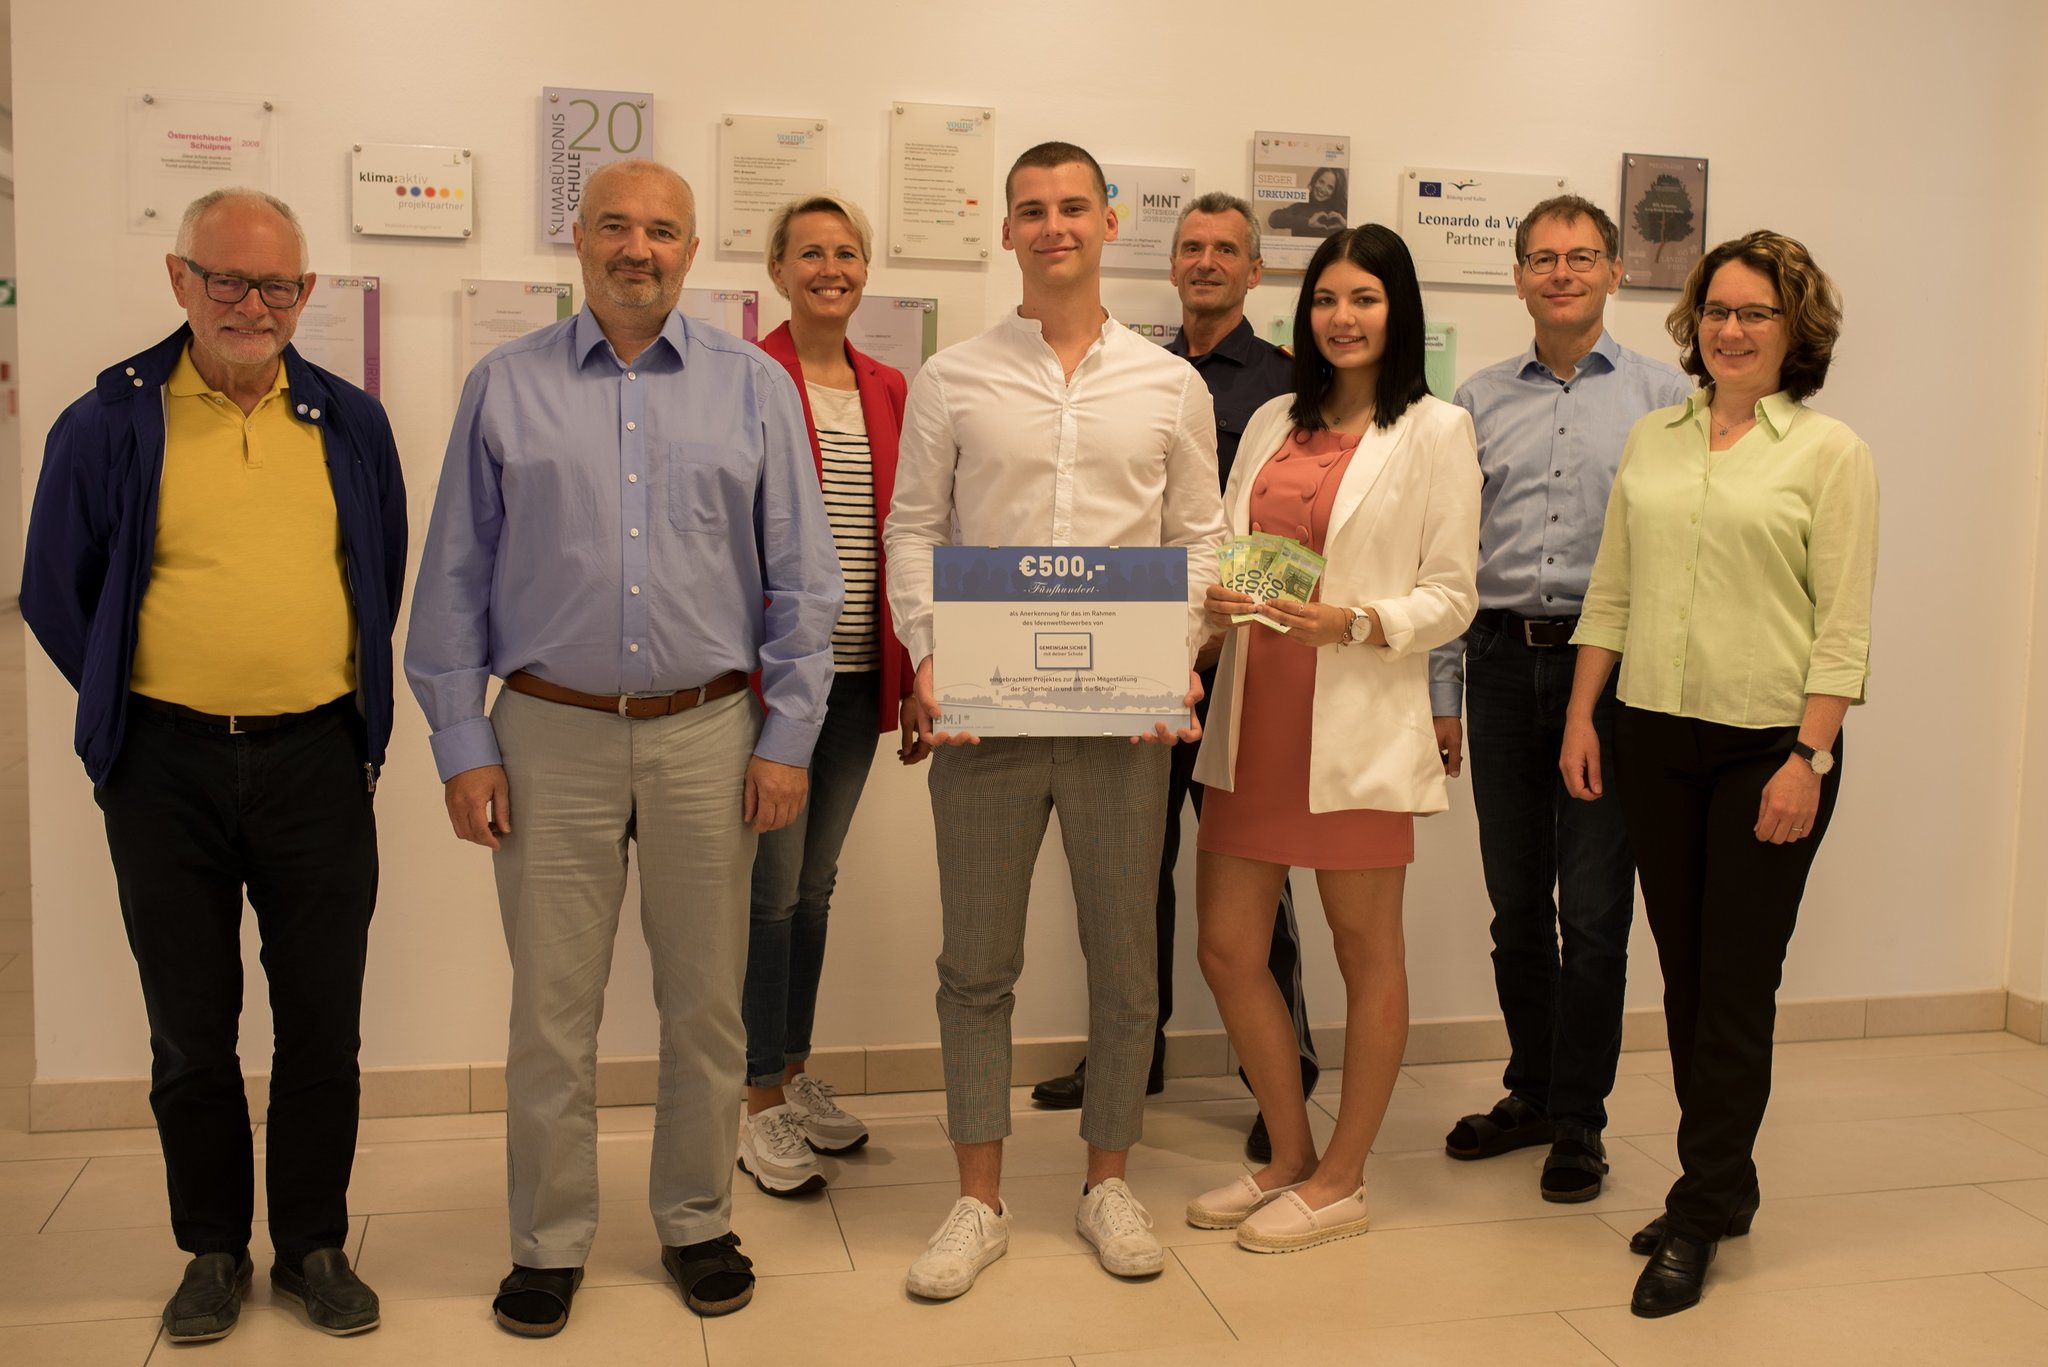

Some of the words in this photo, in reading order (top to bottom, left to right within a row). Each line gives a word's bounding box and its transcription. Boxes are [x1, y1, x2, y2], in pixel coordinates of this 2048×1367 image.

[567, 98, 642, 154] 20
[168, 130, 232, 142] Österreichischer
[190, 142, 232, 151] Schulpreis
[359, 171, 428, 184] klima:aktiv
[549, 112, 566, 233] KLIMABÜNDNIS
[567, 152, 581, 211] SCHULE
[1258, 174, 1293, 185] SIEGER
[1142, 193, 1181, 208] MINT
[1258, 189, 1307, 201] URKUNDE
[398, 200, 464, 211] projektpartner
[1418, 211, 1480, 228] Leonardo
[1485, 215, 1501, 229] da
[1505, 216, 1521, 229] Vi
[1446, 231, 1495, 247] Partner
[1018, 555, 1106, 582] €500,-
[1019, 610, 1060, 618] Anerkennung
[1033, 676, 1062, 684] Projektes
[1096, 676, 1138, 684] Mitgestaltung
